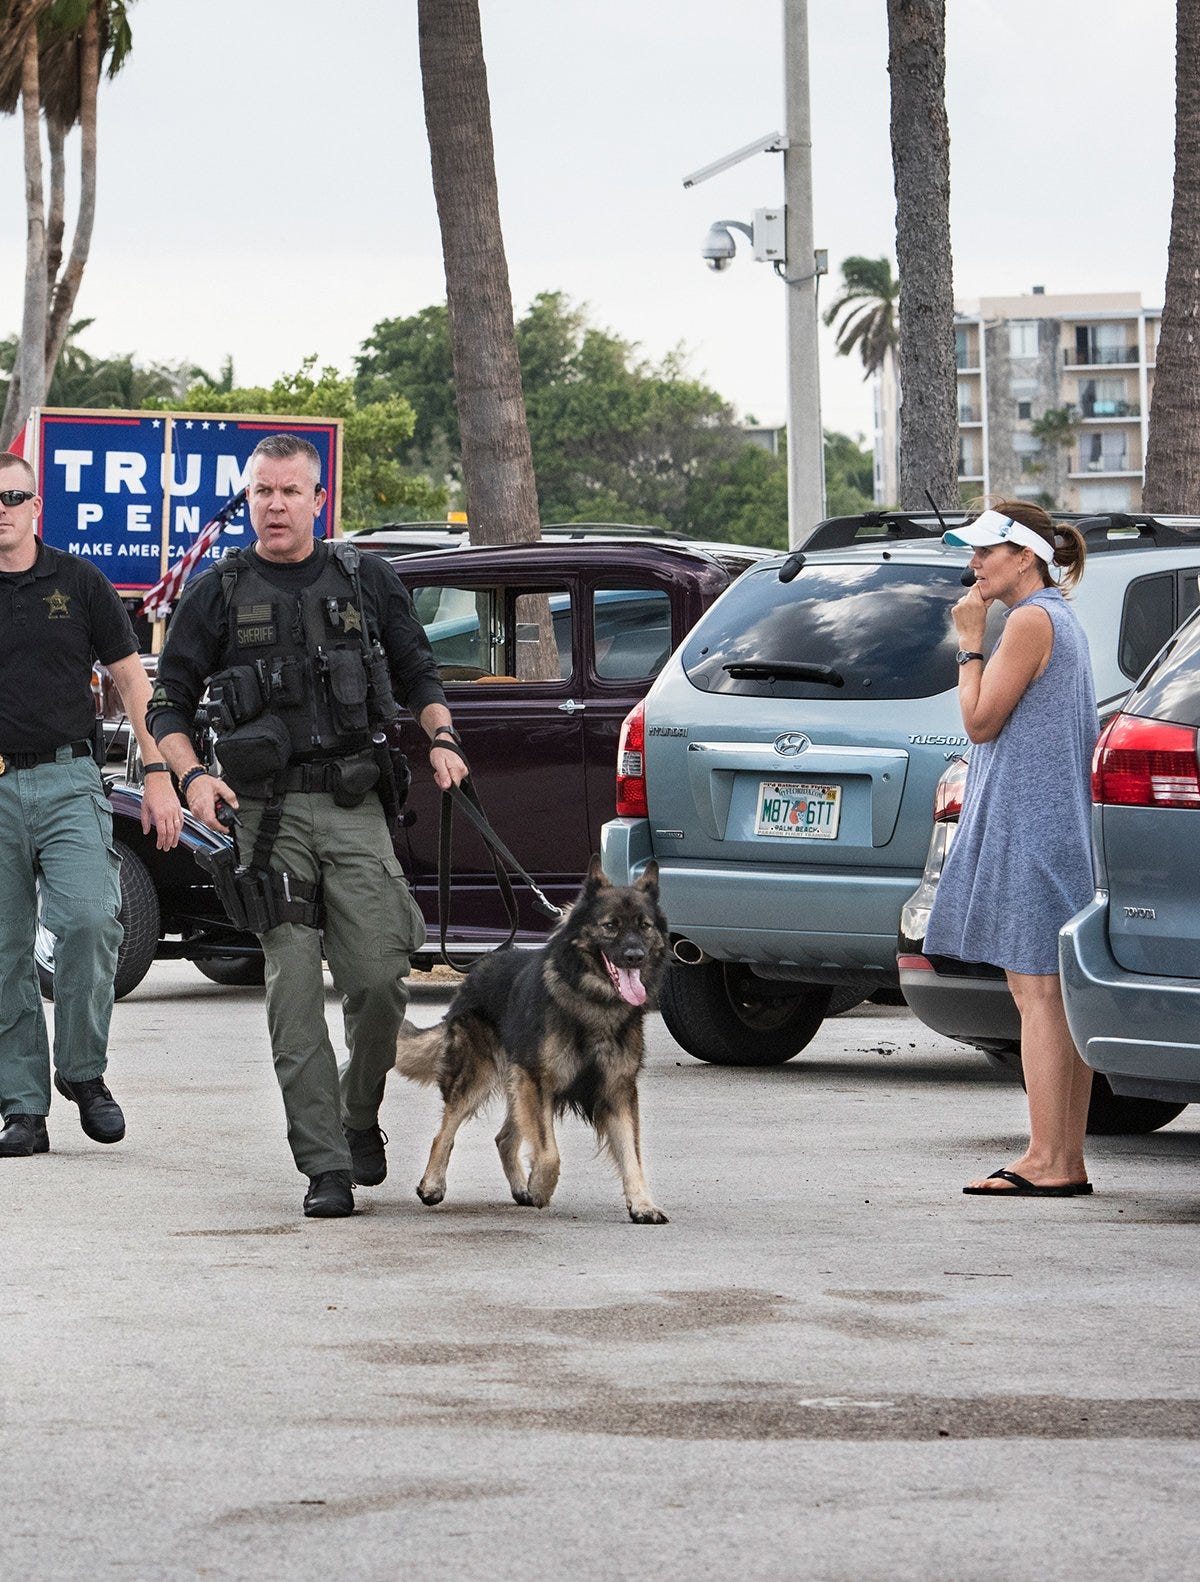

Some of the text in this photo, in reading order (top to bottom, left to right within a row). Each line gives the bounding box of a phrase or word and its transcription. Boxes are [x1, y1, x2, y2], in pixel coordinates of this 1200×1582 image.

[54, 449, 253, 498] TRUM
[77, 503, 245, 535] PEN
[68, 542, 113, 556] MAKE
[117, 543, 186, 558] AMERCA
[237, 626, 274, 644] SHERIFF
[648, 725, 689, 737] HYUNDAI
[908, 734, 969, 746] TUCSON
[761, 799, 835, 825] M87 6TT
[1123, 906, 1156, 920] TOYOTA
